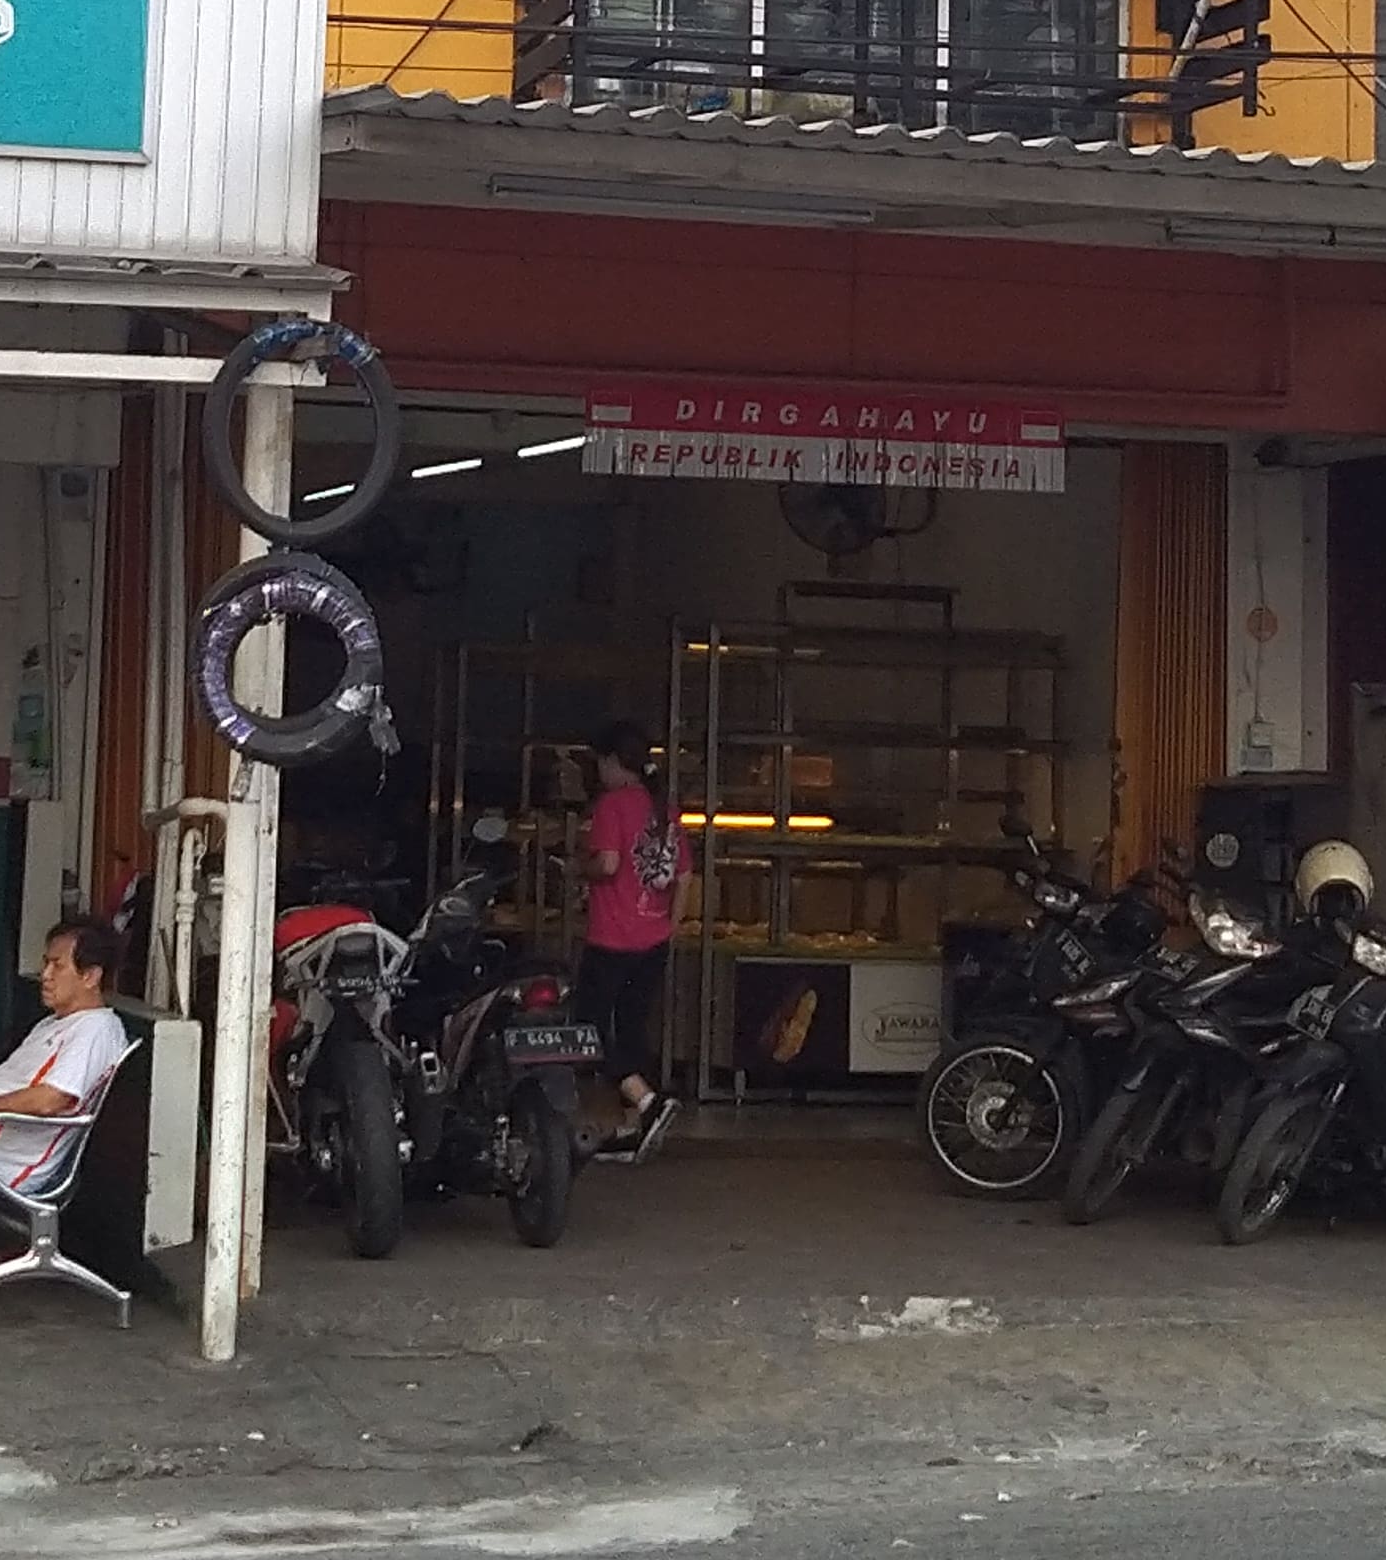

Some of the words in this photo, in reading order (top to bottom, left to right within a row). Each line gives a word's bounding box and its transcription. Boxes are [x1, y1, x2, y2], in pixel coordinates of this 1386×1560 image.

[675, 398, 989, 435] DIRGAHAYU
[629, 441, 805, 470] REPUBLIK
[835, 449, 1024, 479] INDONESIA
